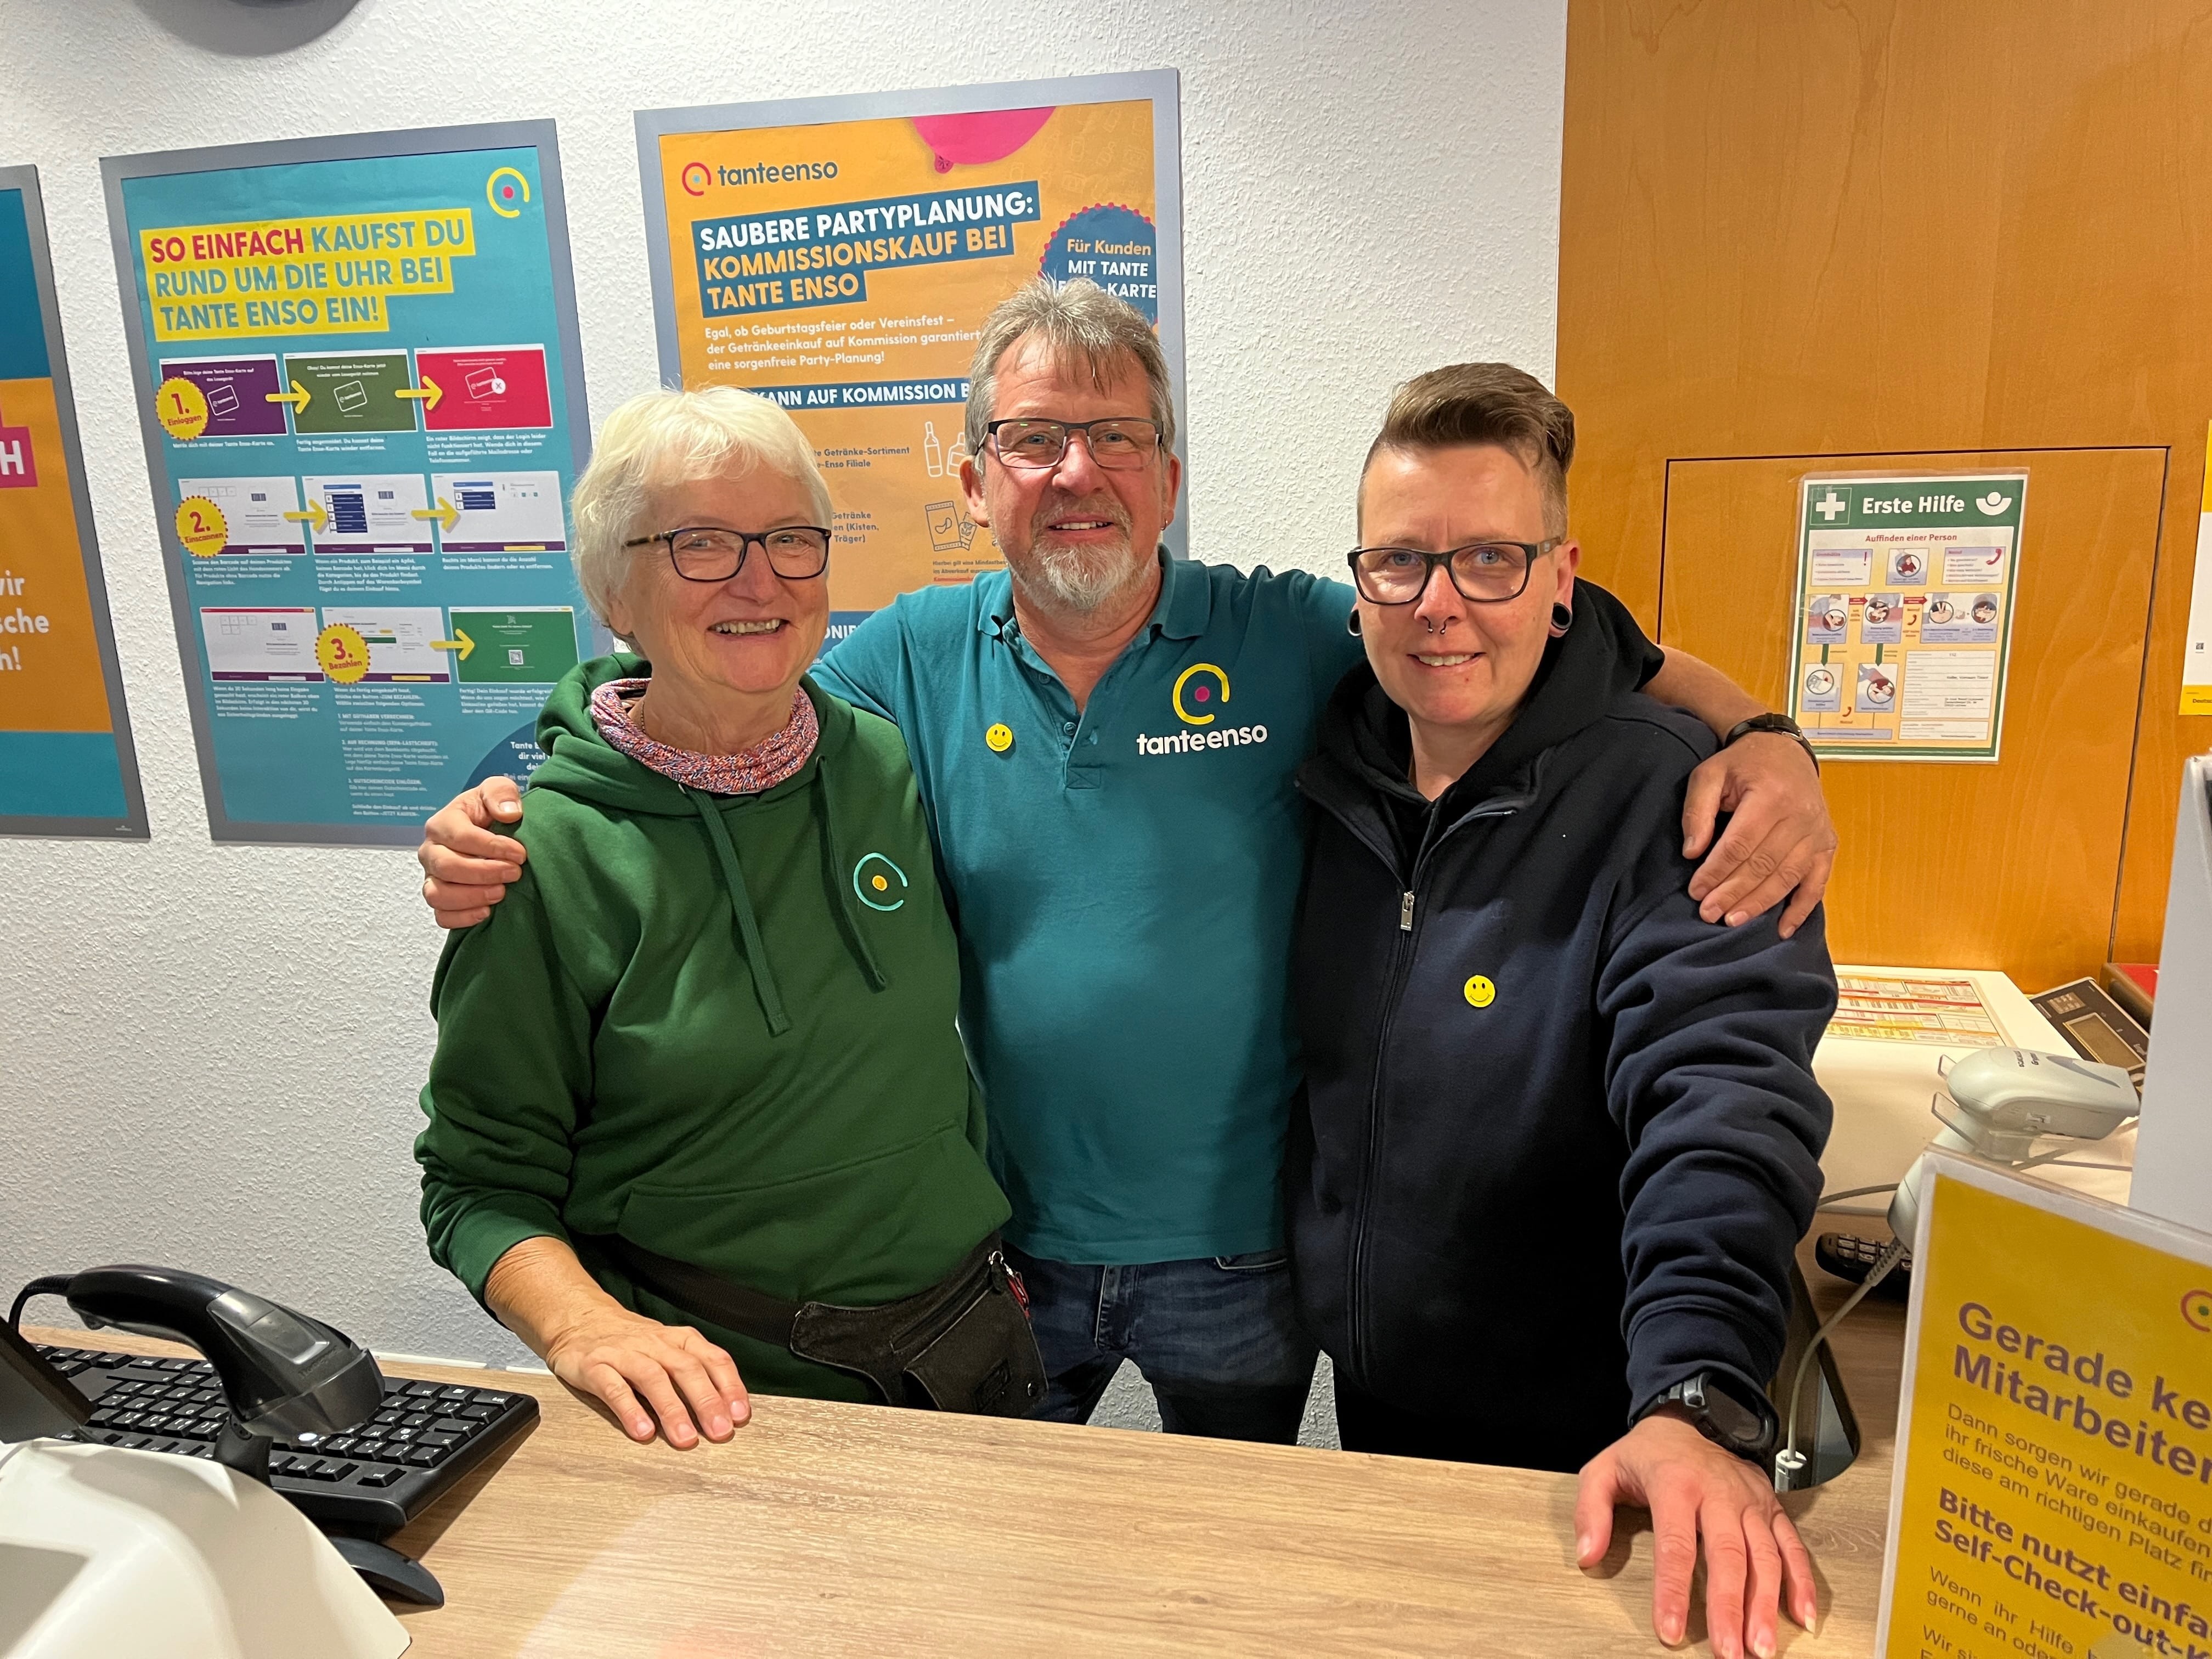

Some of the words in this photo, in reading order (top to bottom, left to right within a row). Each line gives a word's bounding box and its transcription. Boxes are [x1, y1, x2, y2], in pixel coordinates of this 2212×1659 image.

[717, 161, 837, 186] tanteenso
[700, 217, 809, 250] SAUBERE
[817, 191, 1033, 237] PARTYPLANUNG:
[150, 236, 185, 263] SO
[193, 228, 304, 259] EINFACH
[311, 222, 415, 252] KAUFST
[425, 219, 464, 246] DU
[704, 226, 957, 280] KOMMISSIONSKAUF
[966, 226, 1006, 251] BEI
[1067, 239, 1091, 253] Für
[1095, 240, 1151, 255] Kunden
[155, 268, 227, 297] RUND
[234, 266, 277, 292] UM
[285, 263, 327, 290] DIE
[335, 260, 393, 287] UHR
[400, 257, 443, 284] BEI
[1068, 259, 1096, 274] MIT
[1101, 262, 1148, 276] TANTE
[708, 280, 783, 309] TANTE
[791, 273, 859, 301] ENSO
[160, 302, 239, 330] TANTE
[245, 299, 318, 326] ENSO
[326, 296, 379, 323] EIN!
[705, 328, 732, 339] Egal,
[734, 326, 748, 337] ob
[751, 321, 847, 337] Geburtstagsfeier
[850, 319, 876, 330] oder
[879, 315, 943, 328] Vereinsfest
[707, 343, 725, 354] der
[727, 338, 821, 353] Getränkeeinkauf
[825, 337, 844, 348] auf
[848, 334, 915, 347] Kommission
[921, 330, 980, 346] garantiert
[708, 360, 731, 371] eine
[734, 356, 797, 370] sorgenfreie
[799, 351, 884, 367] Party-Planung!
[171, 393, 190, 414] 1.
[806, 388, 837, 404] AUF
[843, 383, 956, 403] KOMMISSION
[167, 414, 202, 426] Einloggen
[824, 447, 910, 456] Getränke-Sortiment
[846, 459, 871, 467] Filiale
[1863, 497, 1912, 514] Erste
[1918, 495, 1965, 513] Hilfe
[190, 511, 211, 533] 2.
[846, 523, 879, 532] (Kisten,
[185, 533, 224, 543] Einscannen
[834, 534, 866, 544] Träger)
[331, 639, 353, 659] 3.
[329, 660, 362, 670] Bezahlen
[1136, 725, 1268, 755] tanteenso
[518, 752, 529, 760] dir
[1959, 1302, 2133, 1398] Gerade
[2151, 1375, 2211, 1430] ke
[1948, 1403, 1998, 1440] Dann
[2005, 1432, 2073, 1472] sorgen
[2080, 1464, 2110, 1487] wir
[2115, 1482, 2191, 1525] gerade
[1945, 1423, 1970, 1446] ihr
[1975, 1437, 2039, 1479] frische
[2045, 1468, 2098, 1506] Ware
[2106, 1500, 2211, 1558] einkaufen
[1943, 1447, 1993, 1480] diese
[1999, 1475, 2029, 1498] am
[2036, 1491, 2121, 1542] richtigen
[2129, 1531, 2182, 1571] Platz
[1939, 1486, 2013, 1543] Bitte
[2022, 1531, 2111, 1591] nutzt
[1927, 1590, 1978, 1625] gerne
[1984, 1622, 2007, 1642] an
[1930, 1565, 1982, 1607] Wenn
[1994, 1600, 2018, 1624] ihr
[2029, 1619, 2074, 1655] Hilfe
[1923, 1624, 1953, 1652] Wir
